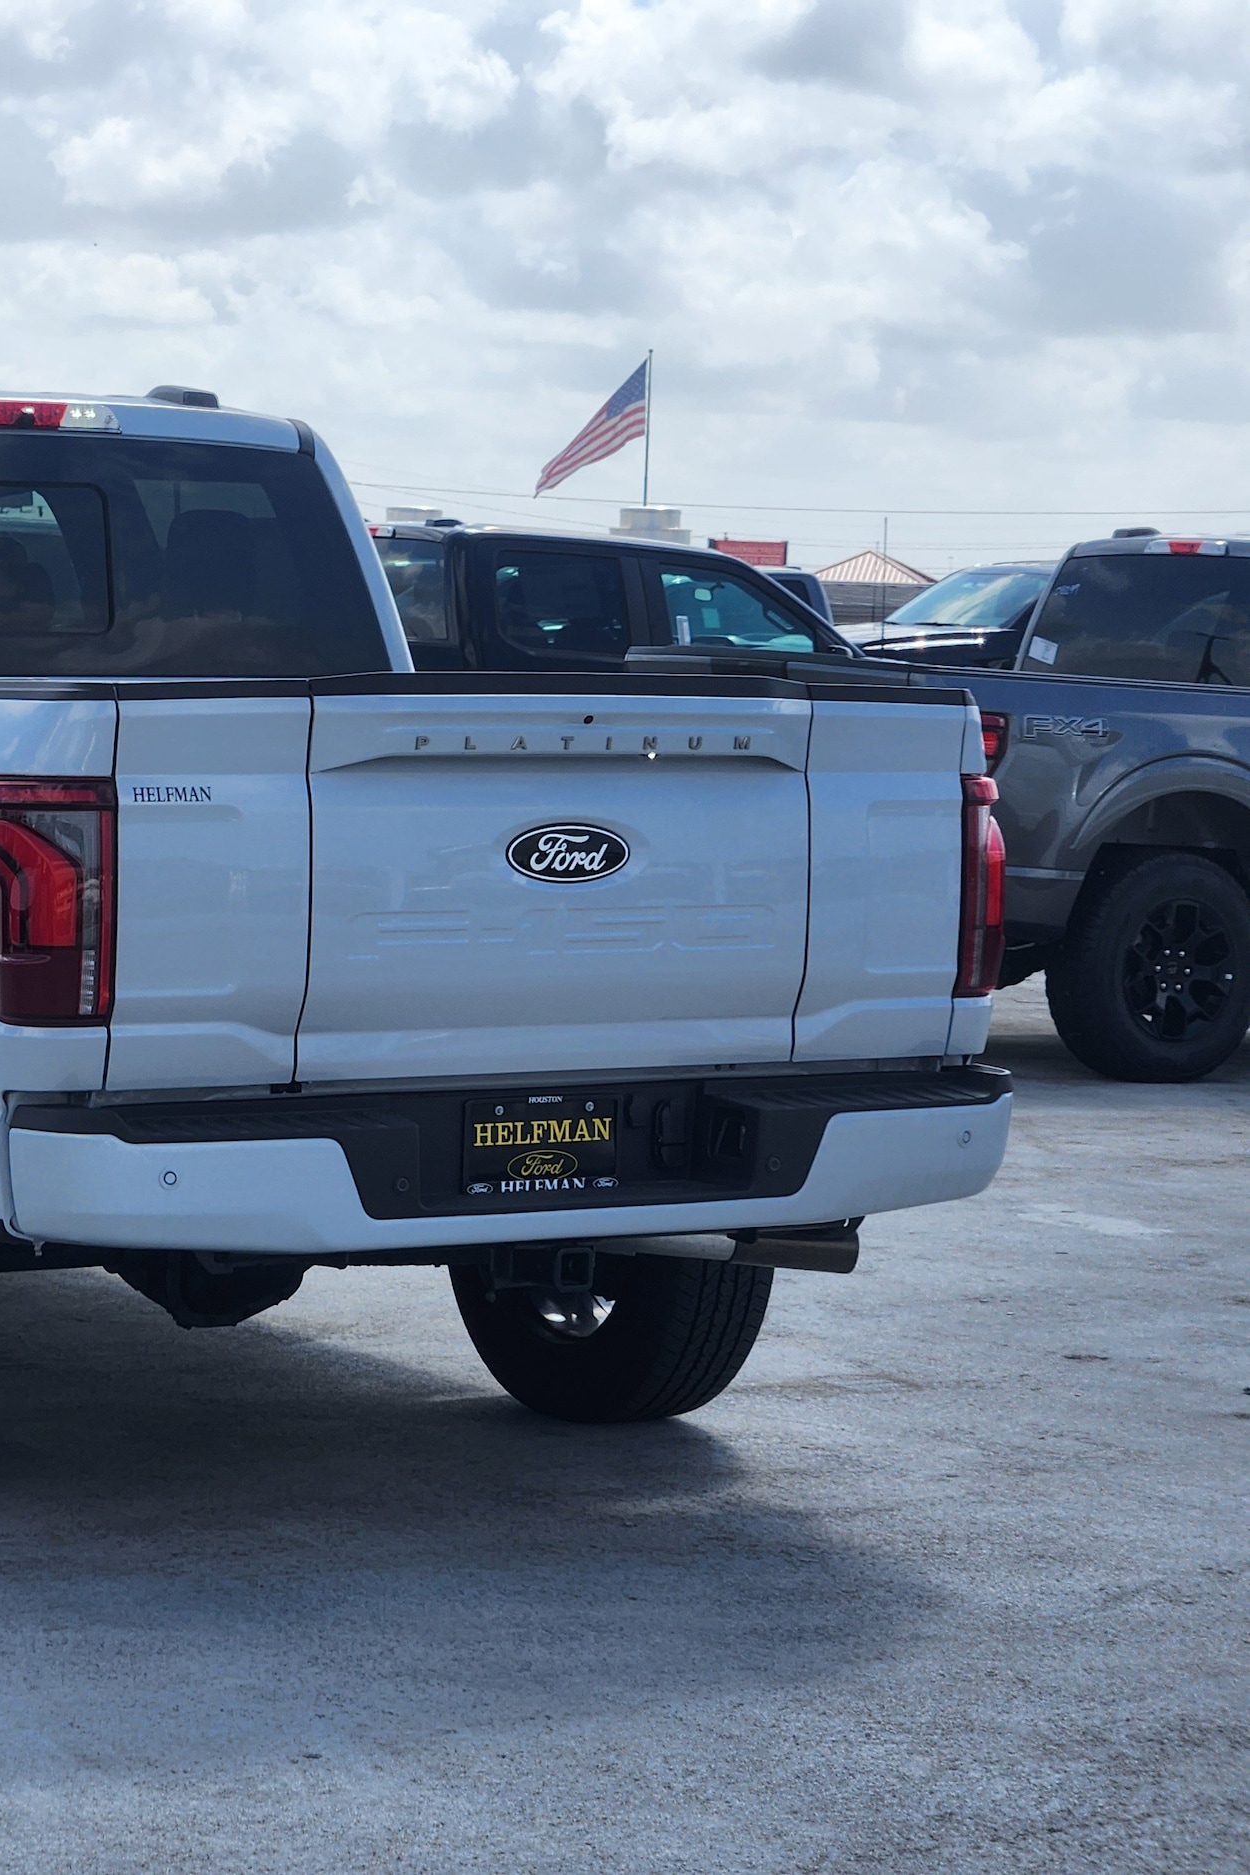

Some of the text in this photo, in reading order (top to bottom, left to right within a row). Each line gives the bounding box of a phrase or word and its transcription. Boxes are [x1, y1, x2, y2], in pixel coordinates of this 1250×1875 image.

[1023, 713, 1110, 740] FX4
[414, 735, 751, 751] PLATINUM
[132, 786, 212, 802] HELFMAN
[529, 832, 607, 872] Ford
[528, 1095, 563, 1104] HOUSTON
[473, 1117, 612, 1147] HELFMAN
[521, 1153, 565, 1176] Ford
